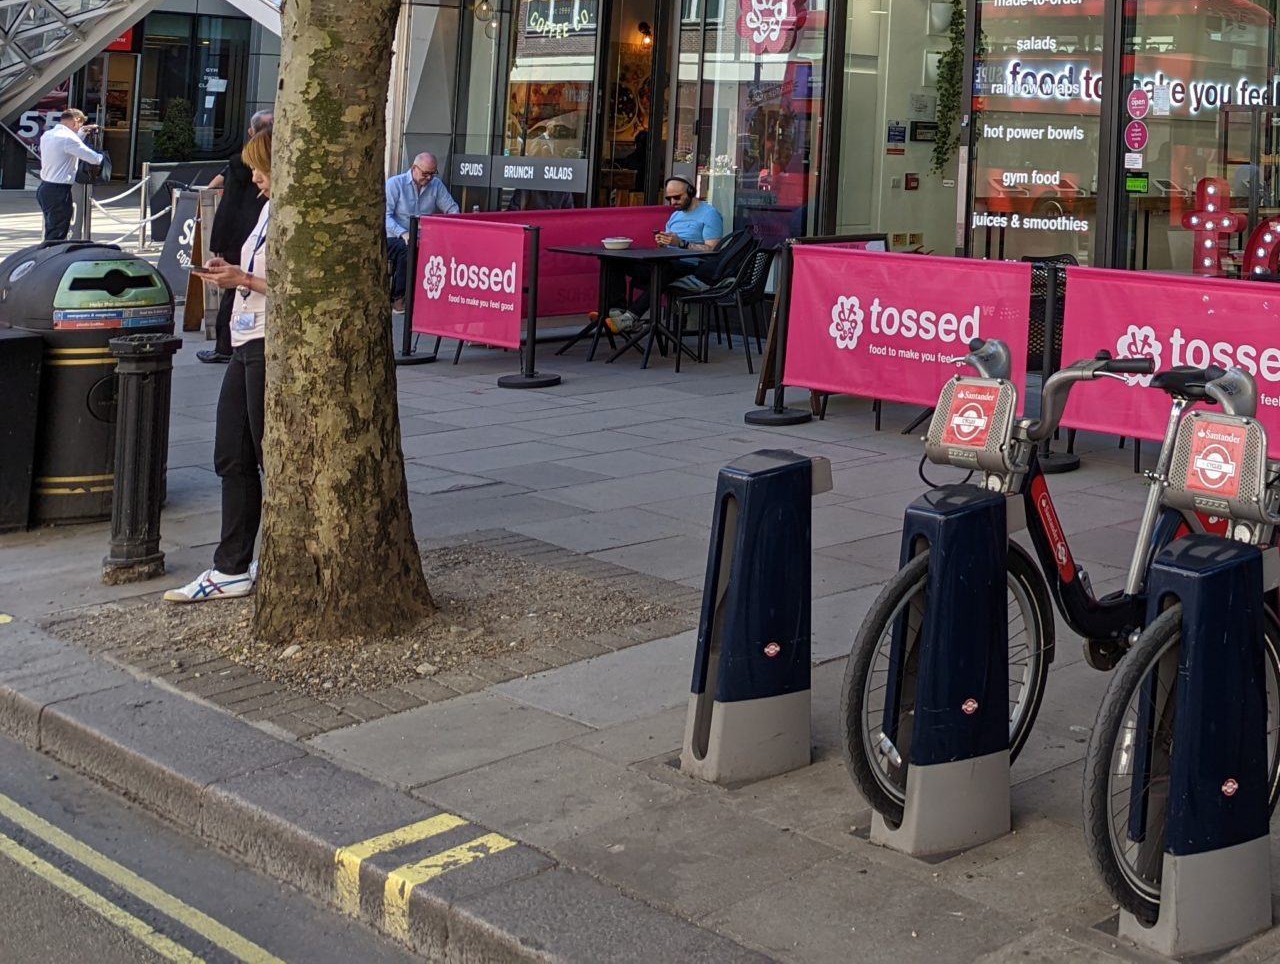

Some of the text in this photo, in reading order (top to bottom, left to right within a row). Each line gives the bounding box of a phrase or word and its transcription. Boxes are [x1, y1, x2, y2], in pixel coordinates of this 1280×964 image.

[530, 12, 570, 39] COFFEE
[1016, 36, 1057, 51] salads
[1190, 83, 1232, 113] you
[983, 124, 1084, 140] hot power bowls
[460, 162, 573, 180] SPUDS BRUNCH SALADS
[1002, 170, 1060, 186] gym food
[972, 212, 1089, 231] juices & smoothies
[450, 256, 517, 294] tossed
[869, 297, 980, 345] tossed
[869, 344, 886, 355] food
[888, 346, 897, 356] to
[898, 349, 919, 360] make
[921, 353, 936, 364] you
[964, 390, 995, 401] Santander
[1205, 429, 1241, 444] Santander
